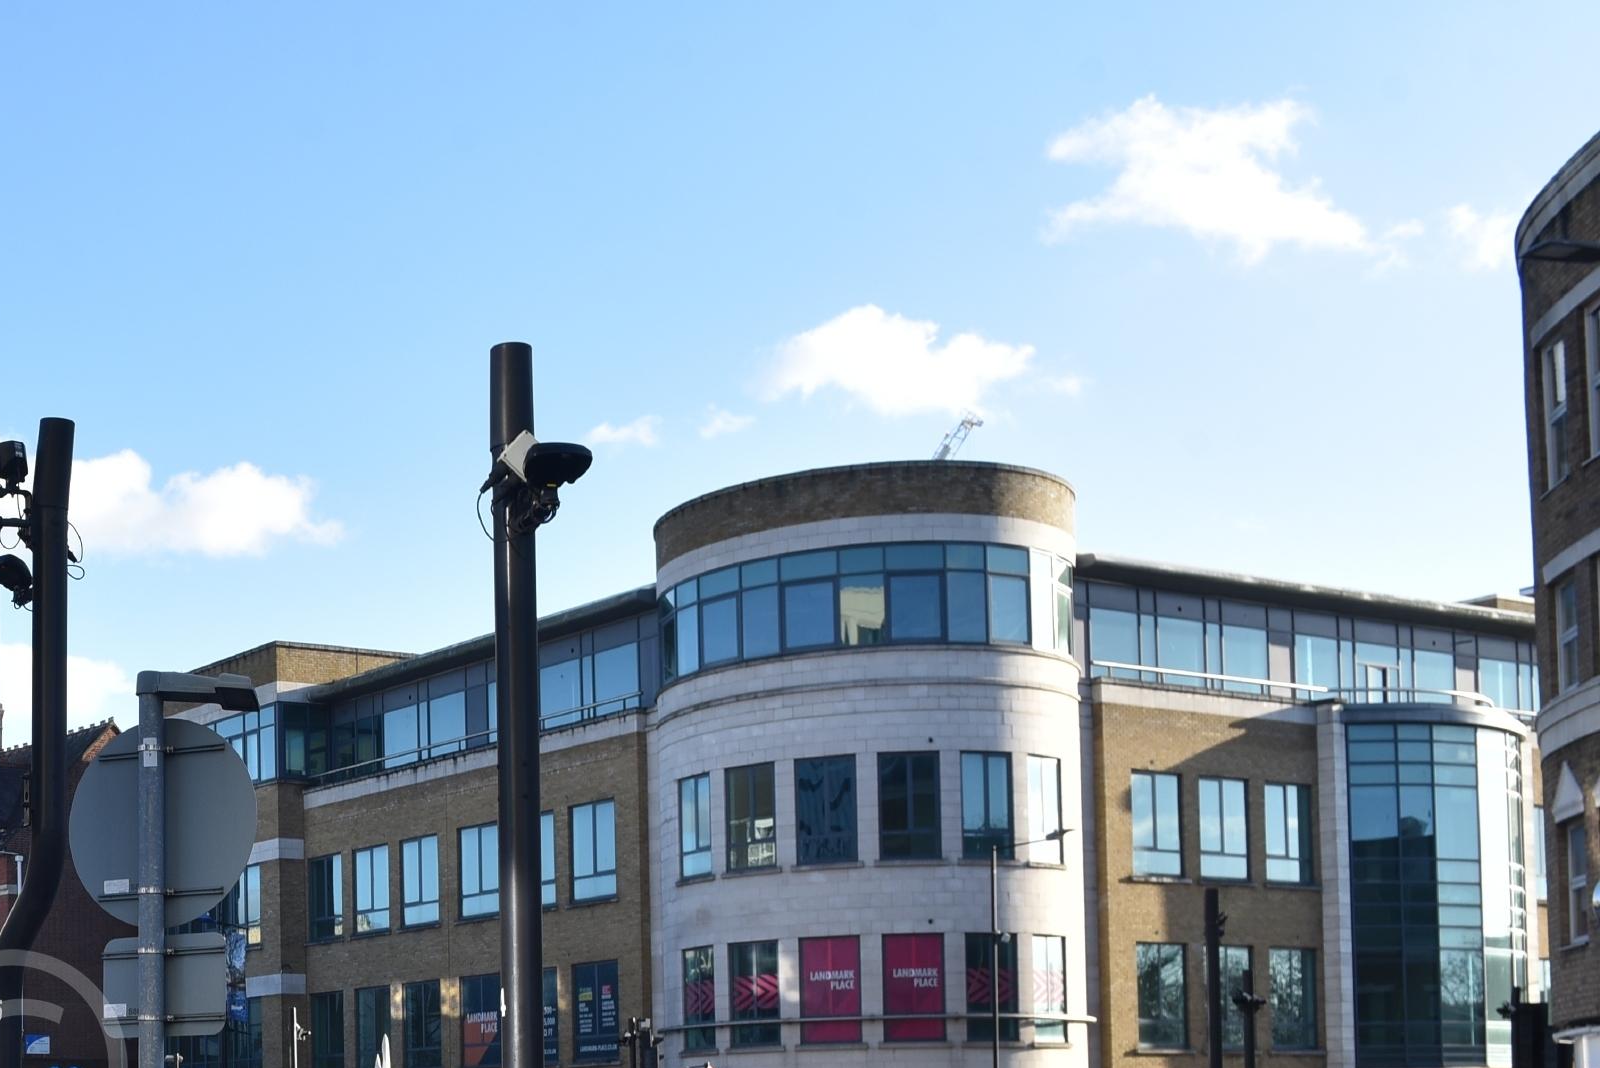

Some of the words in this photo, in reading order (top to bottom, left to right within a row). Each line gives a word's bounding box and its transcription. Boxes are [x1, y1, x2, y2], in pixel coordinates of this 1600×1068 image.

[810, 970, 855, 981] LANDMARK
[893, 968, 938, 978] LANDMARK
[830, 979, 855, 990] PLACE
[913, 977, 938, 987] PLACE
[467, 1011, 498, 1023] LANDMARK
